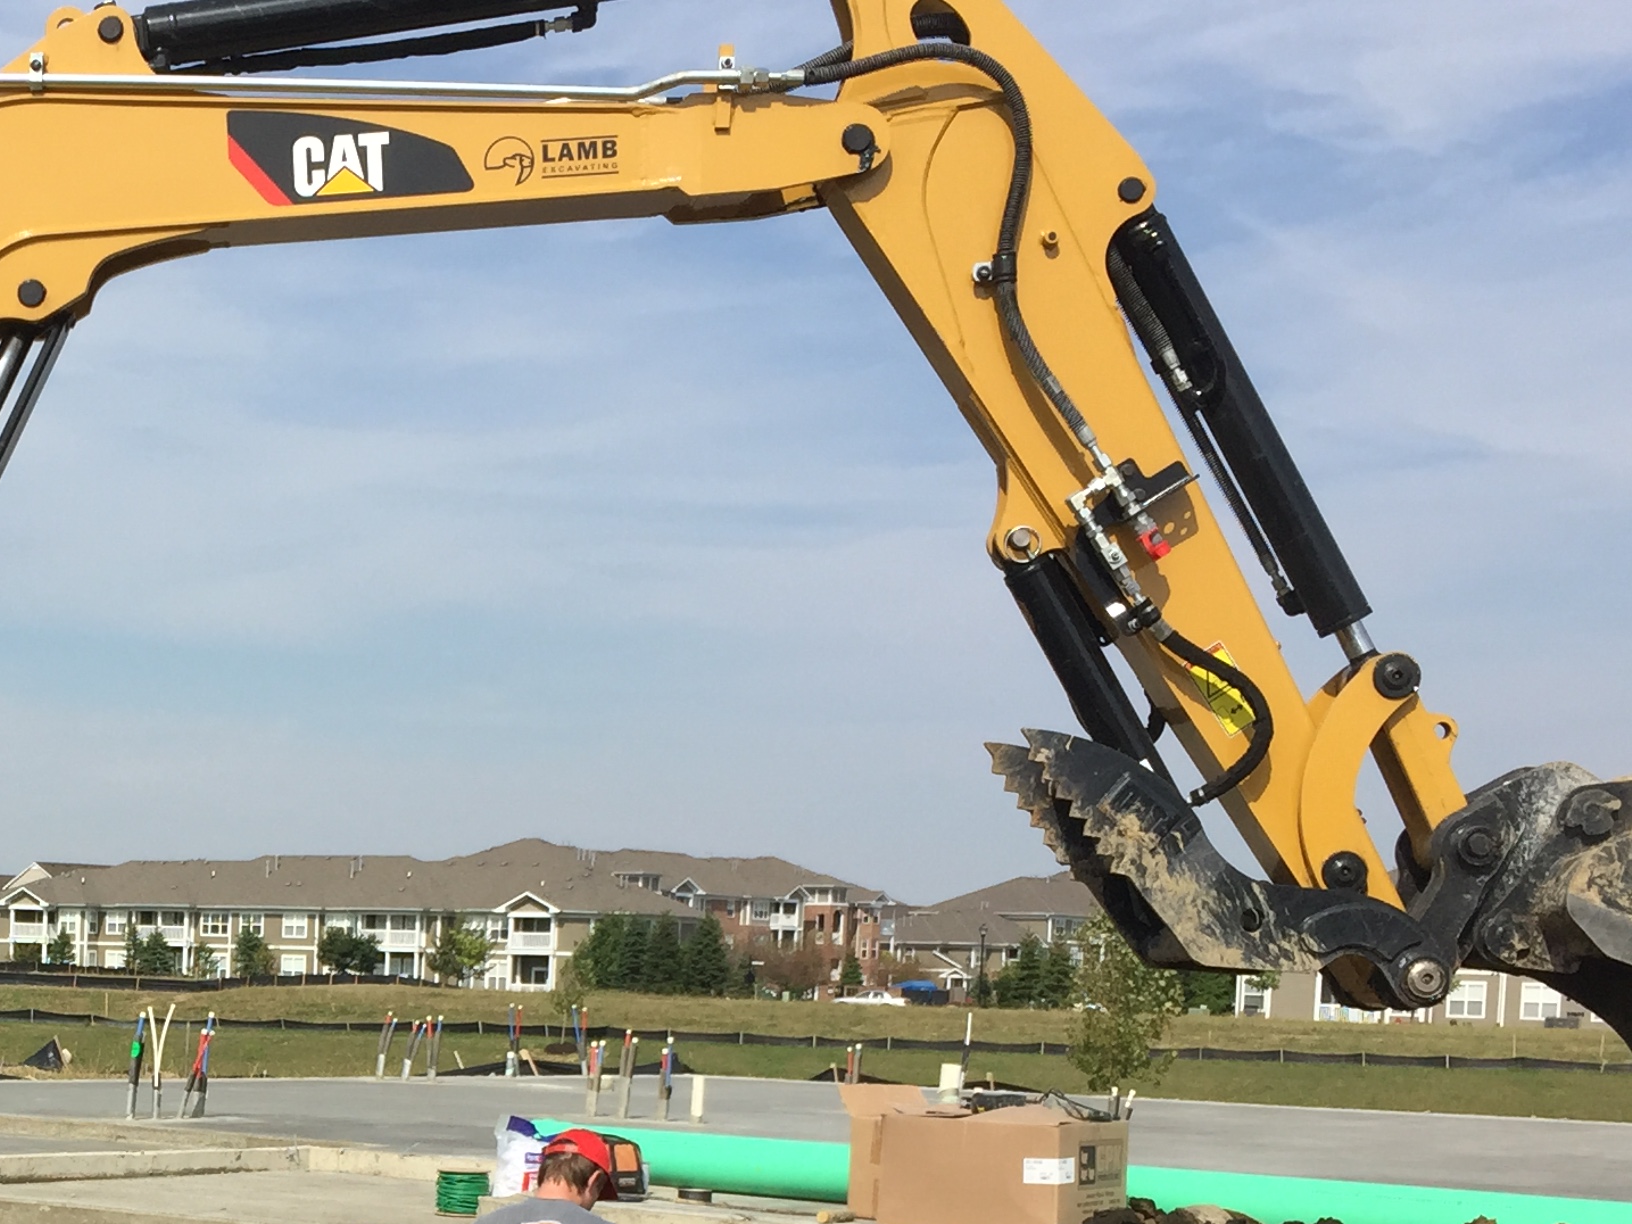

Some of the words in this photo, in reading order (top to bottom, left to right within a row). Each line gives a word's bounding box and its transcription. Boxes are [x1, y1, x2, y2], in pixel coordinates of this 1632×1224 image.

[542, 140, 618, 163] LAMB
[292, 131, 390, 197] CAT
[542, 162, 618, 174] EXCAVATING
